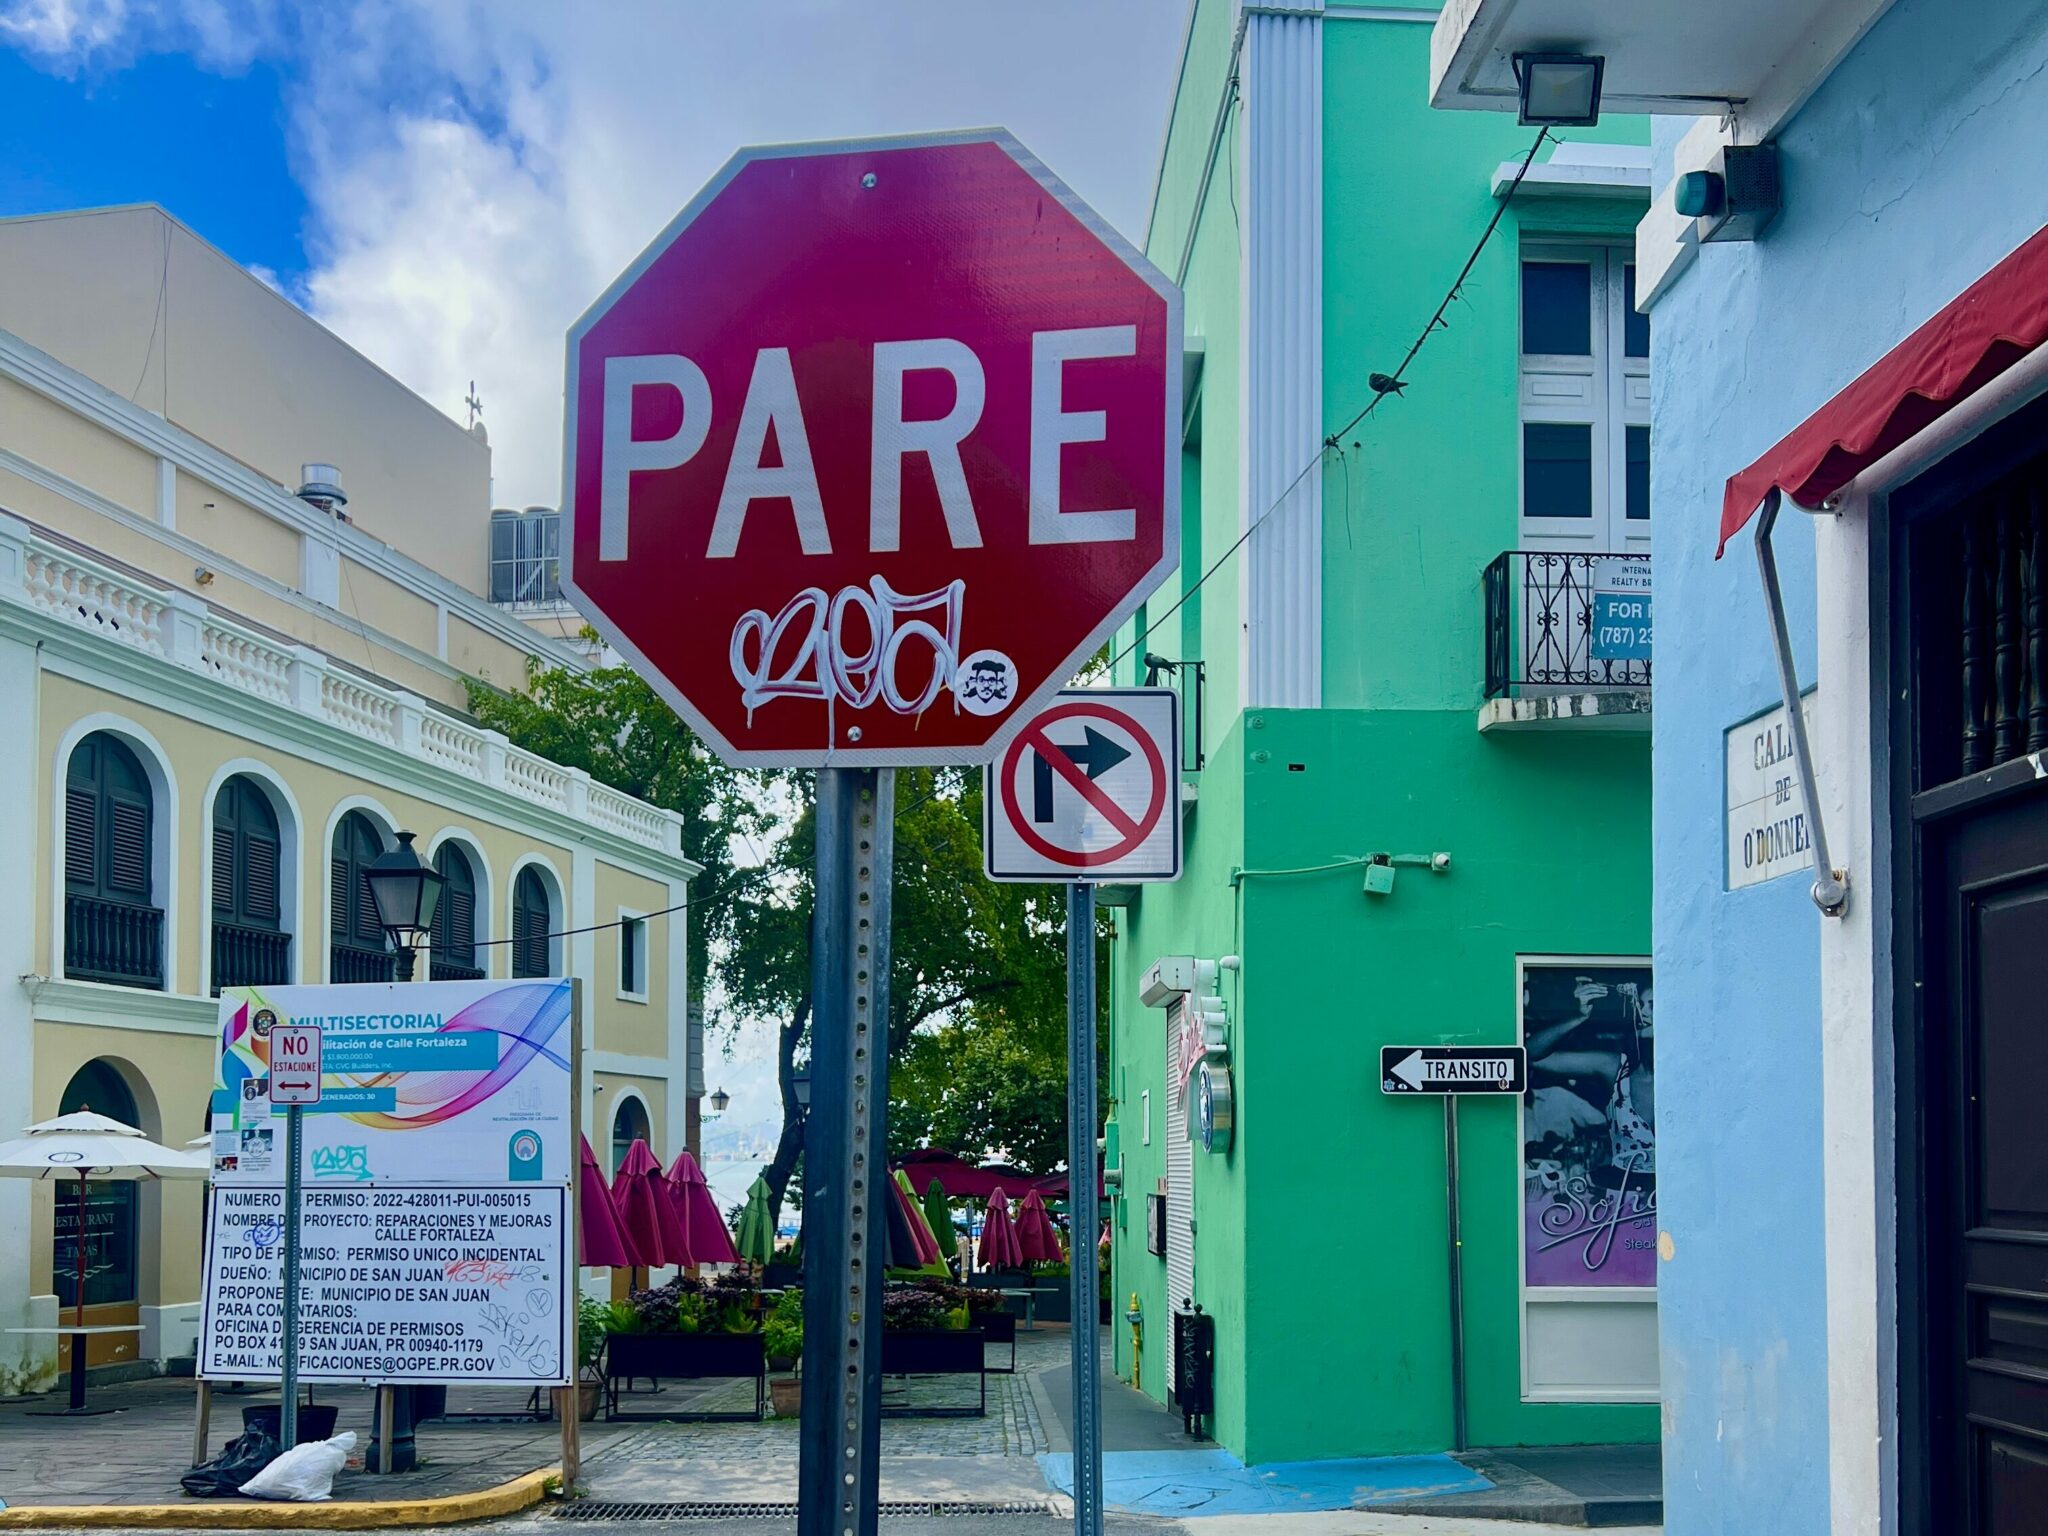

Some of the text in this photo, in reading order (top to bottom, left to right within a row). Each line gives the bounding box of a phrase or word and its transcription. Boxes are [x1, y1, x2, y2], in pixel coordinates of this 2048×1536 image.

[599, 324, 1136, 561] PARE
[1612, 577, 1639, 586] REALTY
[1609, 603, 1642, 618] FOR
[1600, 626, 1635, 648] (787)
[1775, 775, 1791, 806] DE
[1743, 813, 1811, 869] O'DONNE
[290, 1013, 445, 1031] MULTISECTORIAL
[283, 1036, 308, 1055] NO
[322, 1036, 467, 1050] ilitación de Calle Fortaleza
[273, 1061, 317, 1073] ESTACIONE
[1425, 1061, 1508, 1079] TRANSITO
[72, 1183, 93, 1196] BR
[225, 1193, 531, 1207] NUMERO PERMISO: 2022-428011-PUI-005015
[55, 1212, 115, 1228] ESTARANT
[223, 1213, 275, 1227] NOMBRE
[304, 1214, 372, 1227] PROYECTO:
[376, 1214, 475, 1228] REPARACIONES
[478, 1214, 486, 1227] Y
[489, 1214, 552, 1228] MEJORAS
[375, 1228, 495, 1241] CALLE FORTALEZA
[222, 1246, 545, 1262] TIPO DE PRMISO: PERMISO UNICO INCIDENTAL
[220, 1264, 272, 1280] DUEÑO:
[279, 1267, 346, 1281] MNICIPIO
[350, 1267, 368, 1281] DE
[372, 1268, 401, 1281] SAN
[405, 1268, 444, 1281] JUAN
[218, 1286, 490, 1302] PROPONEE: MUNICIPIO DE SAN JUAN
[217, 1303, 357, 1318] PARA COMNTARIOS:
[215, 1320, 269, 1333] OFICINA
[297, 1321, 364, 1335] GERENCIA
[367, 1322, 386, 1335] DE
[390, 1322, 464, 1336] PERMISOS
[215, 1335, 483, 1353] PO BOX 419 SAN JUAN, PR 00940-1179
[214, 1354, 495, 1374] E-MAIL: NOFICACIONES@OGPE.PR.GOV
